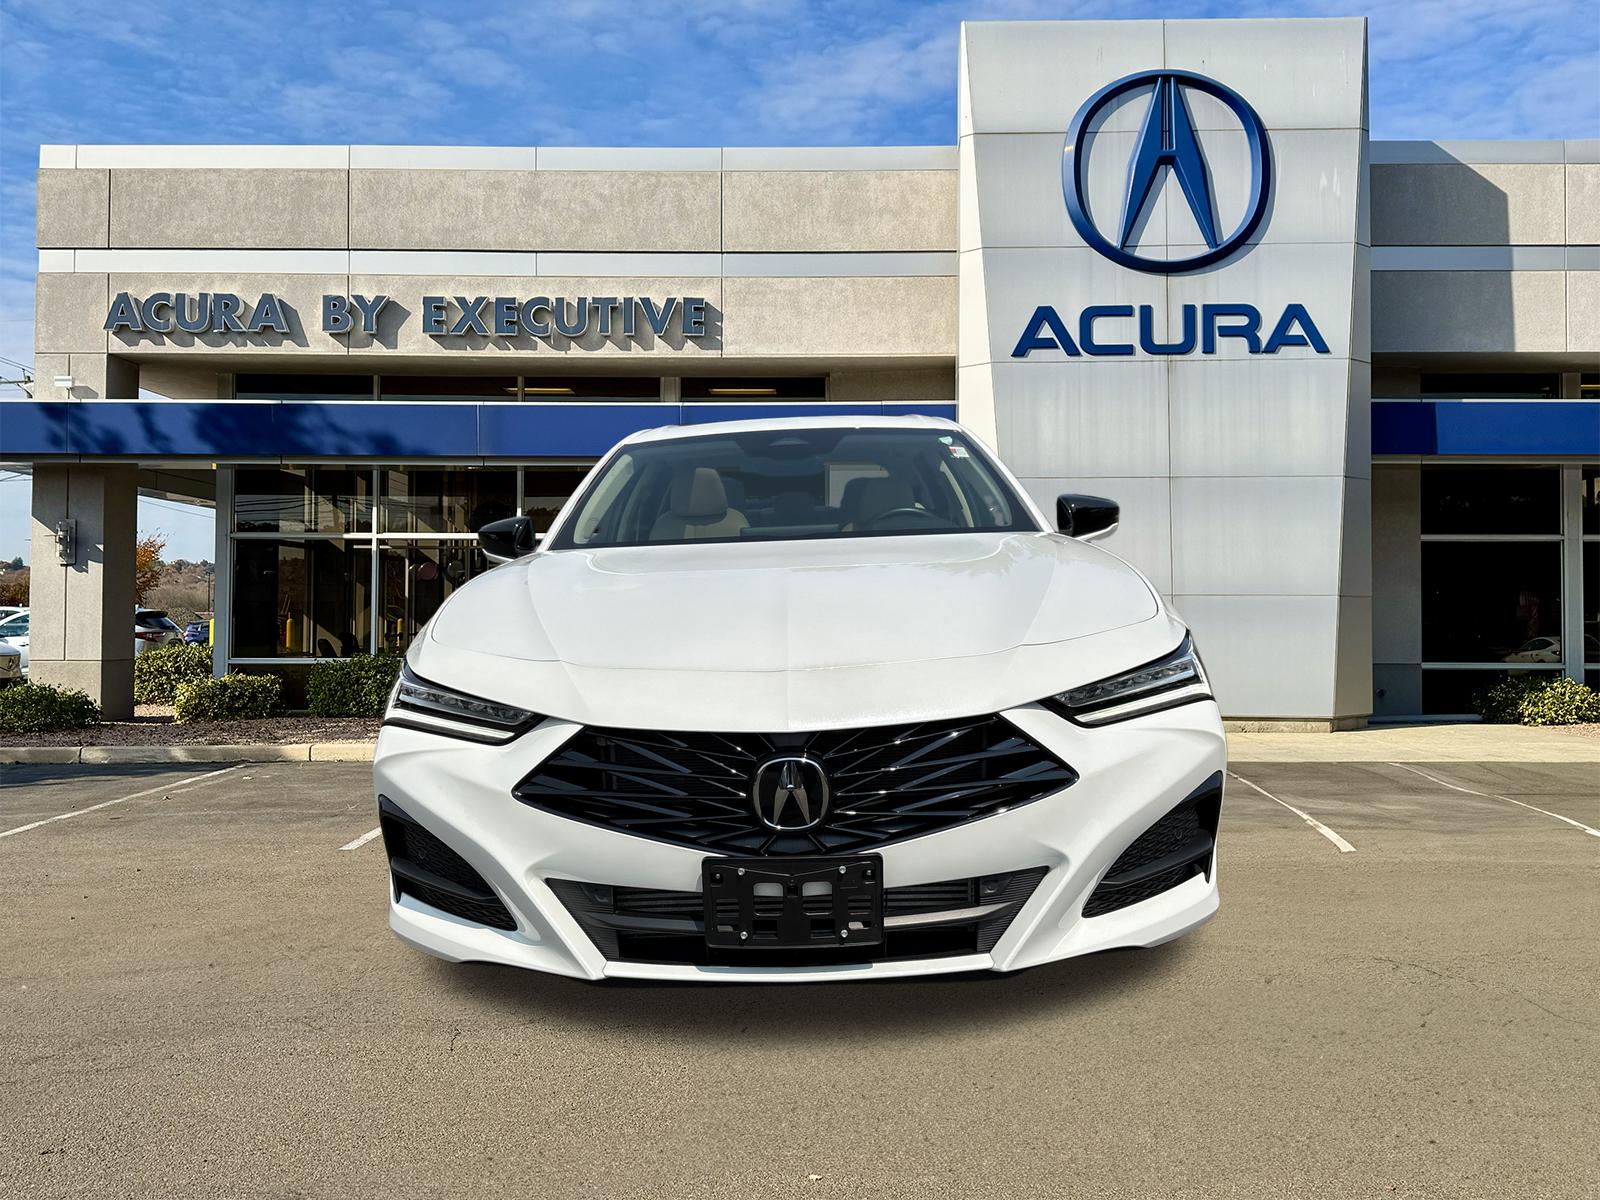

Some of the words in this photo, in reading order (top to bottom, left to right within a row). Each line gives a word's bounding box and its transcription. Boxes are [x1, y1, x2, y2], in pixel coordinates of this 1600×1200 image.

[103, 292, 290, 334] ACURA
[322, 295, 391, 335] BY
[422, 296, 707, 337] EXECUTIVE
[1010, 303, 1331, 357] ACURA
